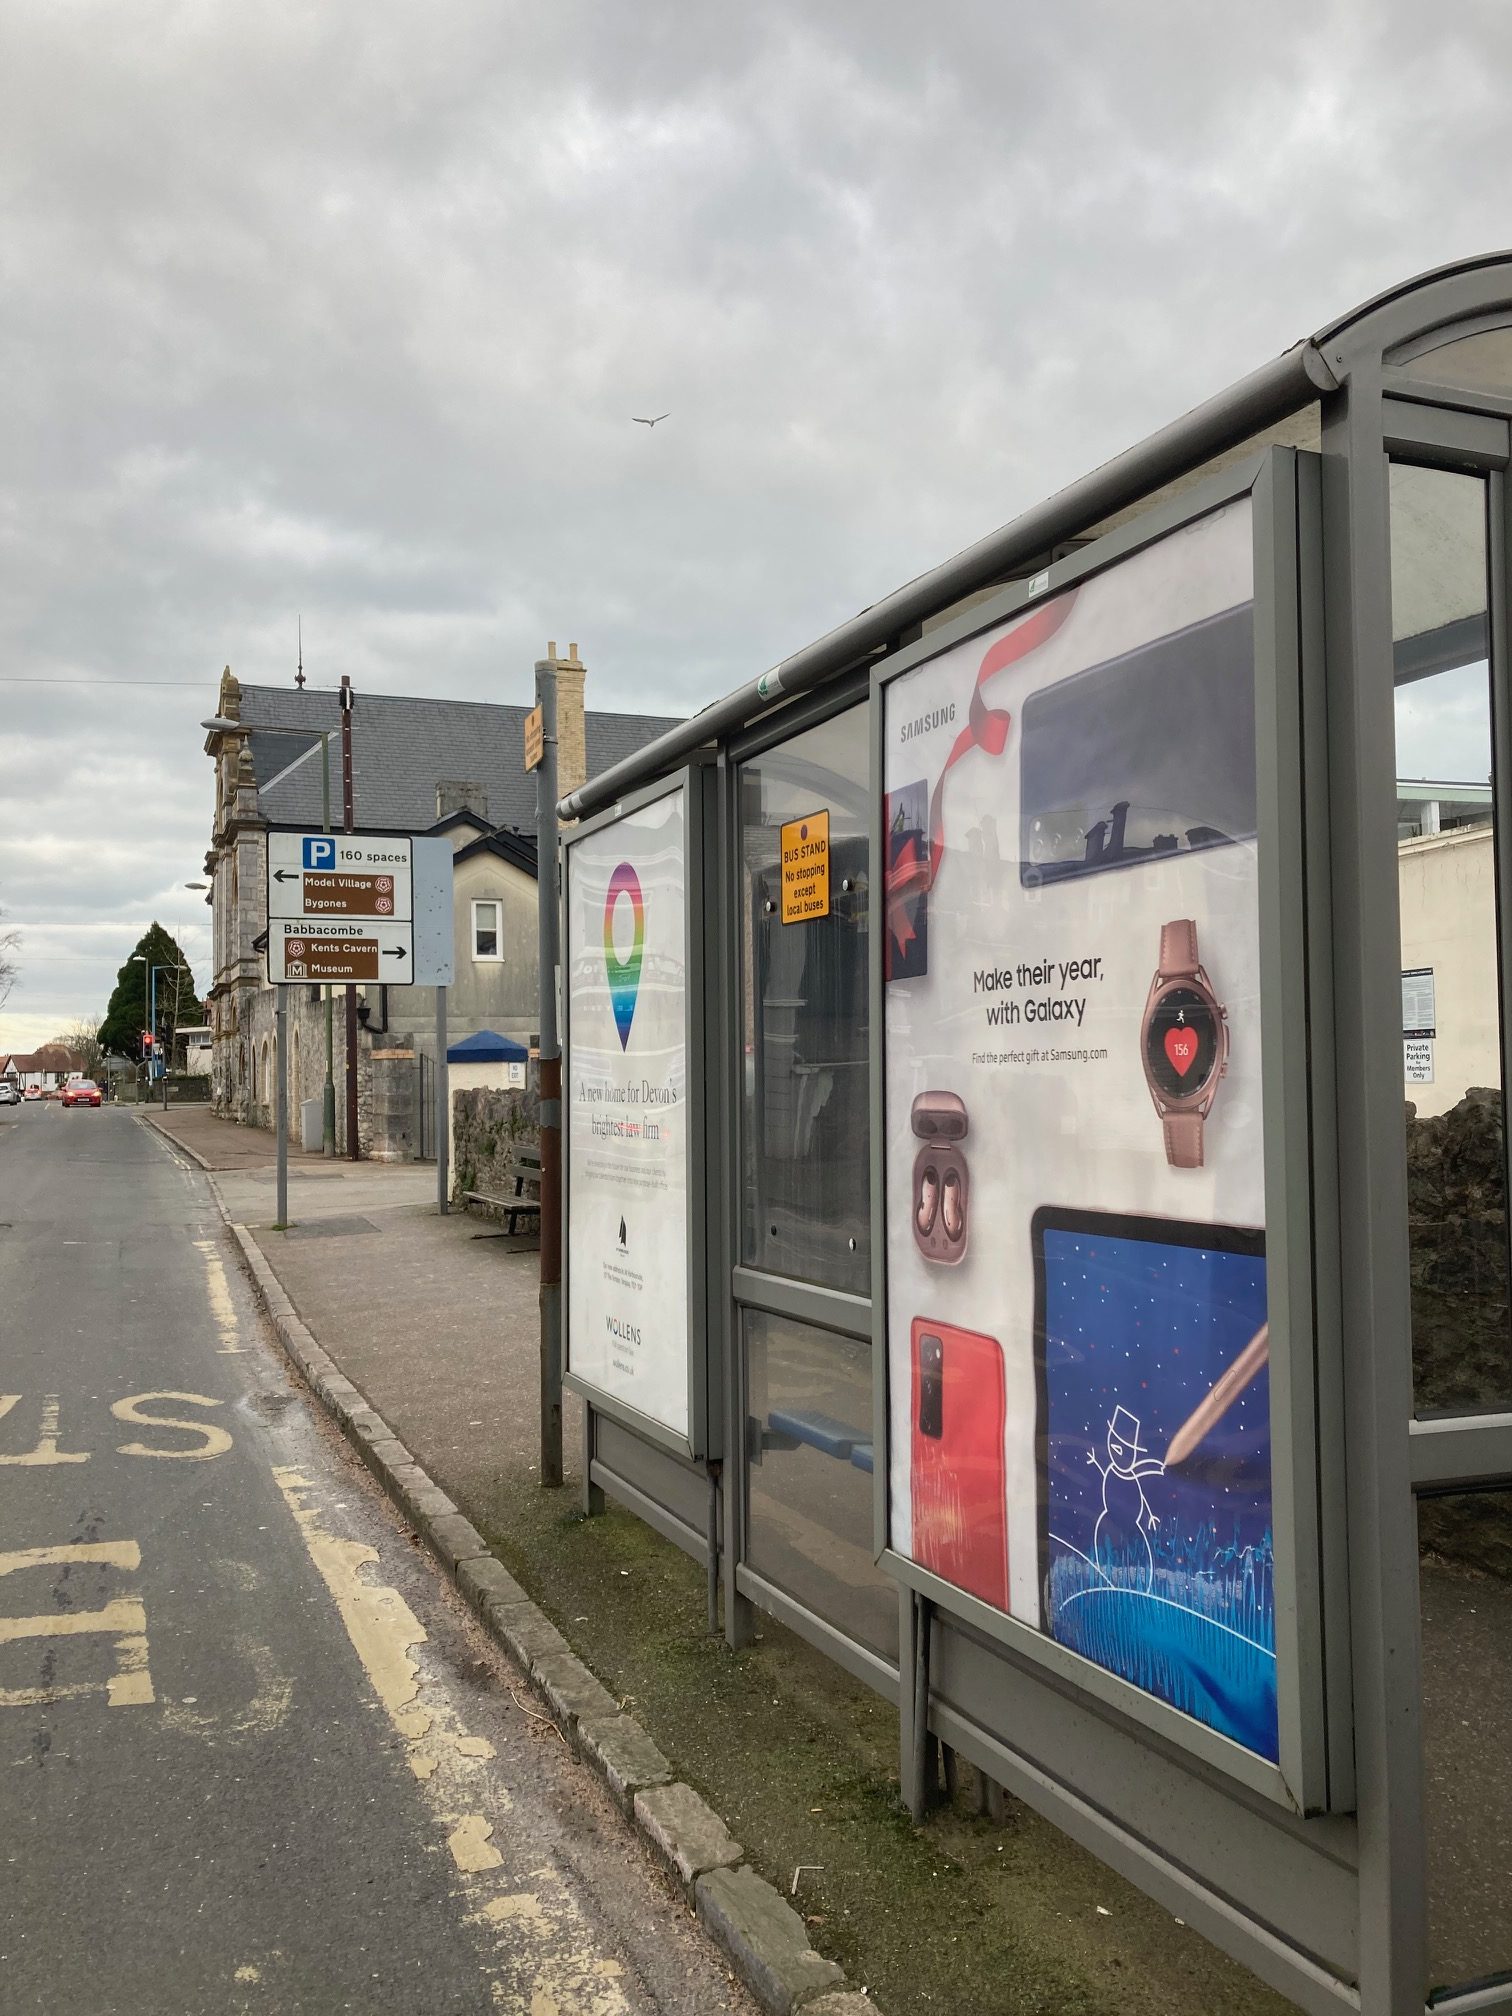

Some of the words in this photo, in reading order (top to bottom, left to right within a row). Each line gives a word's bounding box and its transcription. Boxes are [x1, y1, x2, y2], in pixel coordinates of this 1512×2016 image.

[900, 703, 956, 743] SAMSUNG
[310, 841, 331, 867] P
[340, 850, 362, 861] 160
[367, 852, 407, 863] spaces
[784, 848, 799, 863] BUS
[801, 840, 826, 859] STAND
[785, 870, 794, 883] No
[796, 864, 825, 881] stopping
[305, 877, 335, 887] Model
[339, 878, 372, 890] Village
[793, 882, 816, 898] except
[305, 898, 347, 909] Bygones
[787, 901, 803, 916] local
[804, 899, 824, 913] buses
[284, 924, 364, 936] Babbacombe
[311, 943, 339, 953] Kents
[342, 944, 378, 953] Cavern
[311, 963, 353, 973] Museum
[973, 967, 1013, 993] Make
[1016, 958, 1056, 987] their
[1058, 957, 1104, 991] year,
[986, 1000, 1020, 1026] with
[1024, 997, 1086, 1027] Galaxy
[972, 1052, 986, 1064] Find
[986, 1052, 998, 1063] the
[999, 1050, 1025, 1065] perfect
[1026, 1049, 1040, 1065] gift
[1041, 1051, 1049, 1061] at
[1050, 1049, 1108, 1063] Samsung.com
[1173, 1043, 1189, 1056] 156
[1406, 1052, 1430, 1061] Parking
[579, 1081, 587, 1102] A
[587, 1088, 605, 1102] new
[604, 1080, 626, 1103] home
[627, 1080, 640, 1103] for
[591, 1112, 624, 1140] brightest
[642, 1115, 660, 1140] firm
[605, 1314, 641, 1345] WOLLENS
